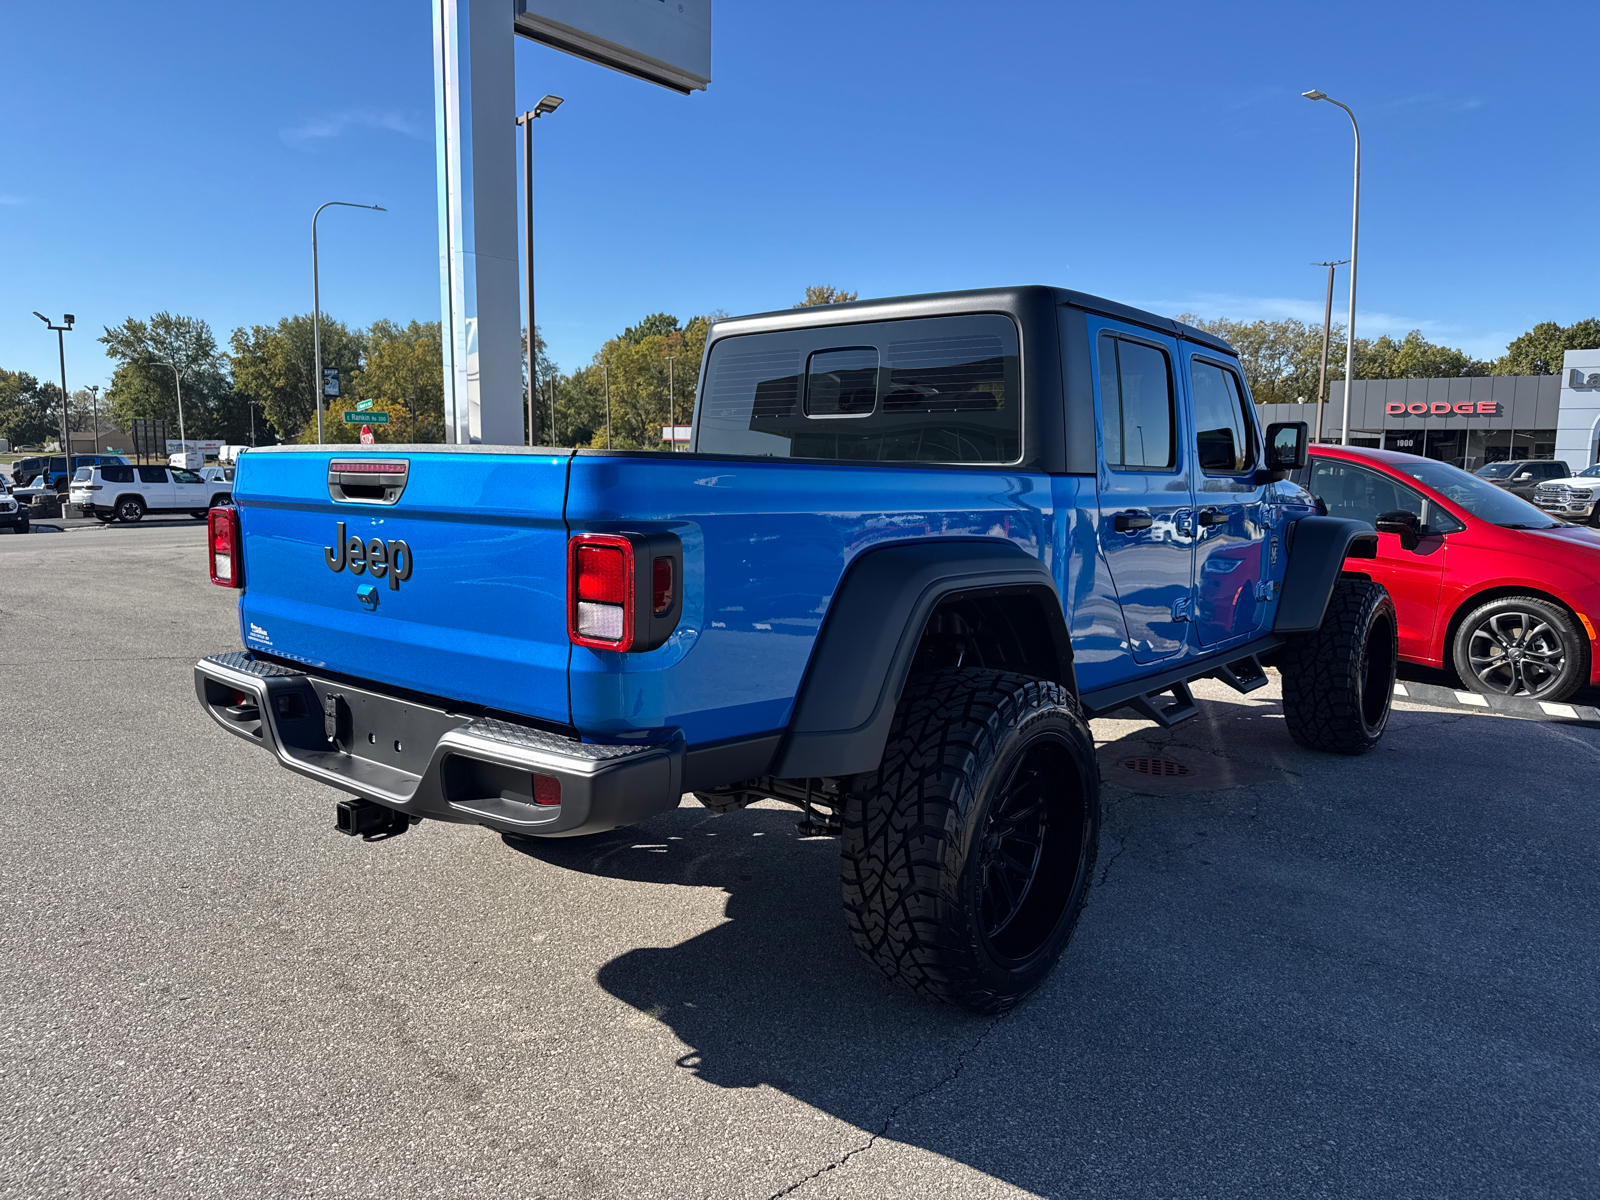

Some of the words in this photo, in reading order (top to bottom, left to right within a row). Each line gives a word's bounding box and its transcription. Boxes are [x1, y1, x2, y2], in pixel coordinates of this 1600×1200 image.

[1569, 368, 1600, 389] La
[1386, 401, 1498, 415] DODGE
[351, 413, 371, 422] Rankin
[361, 433, 374, 444] STOP
[1396, 439, 1414, 447] 1900
[324, 521, 414, 592] Jeep
